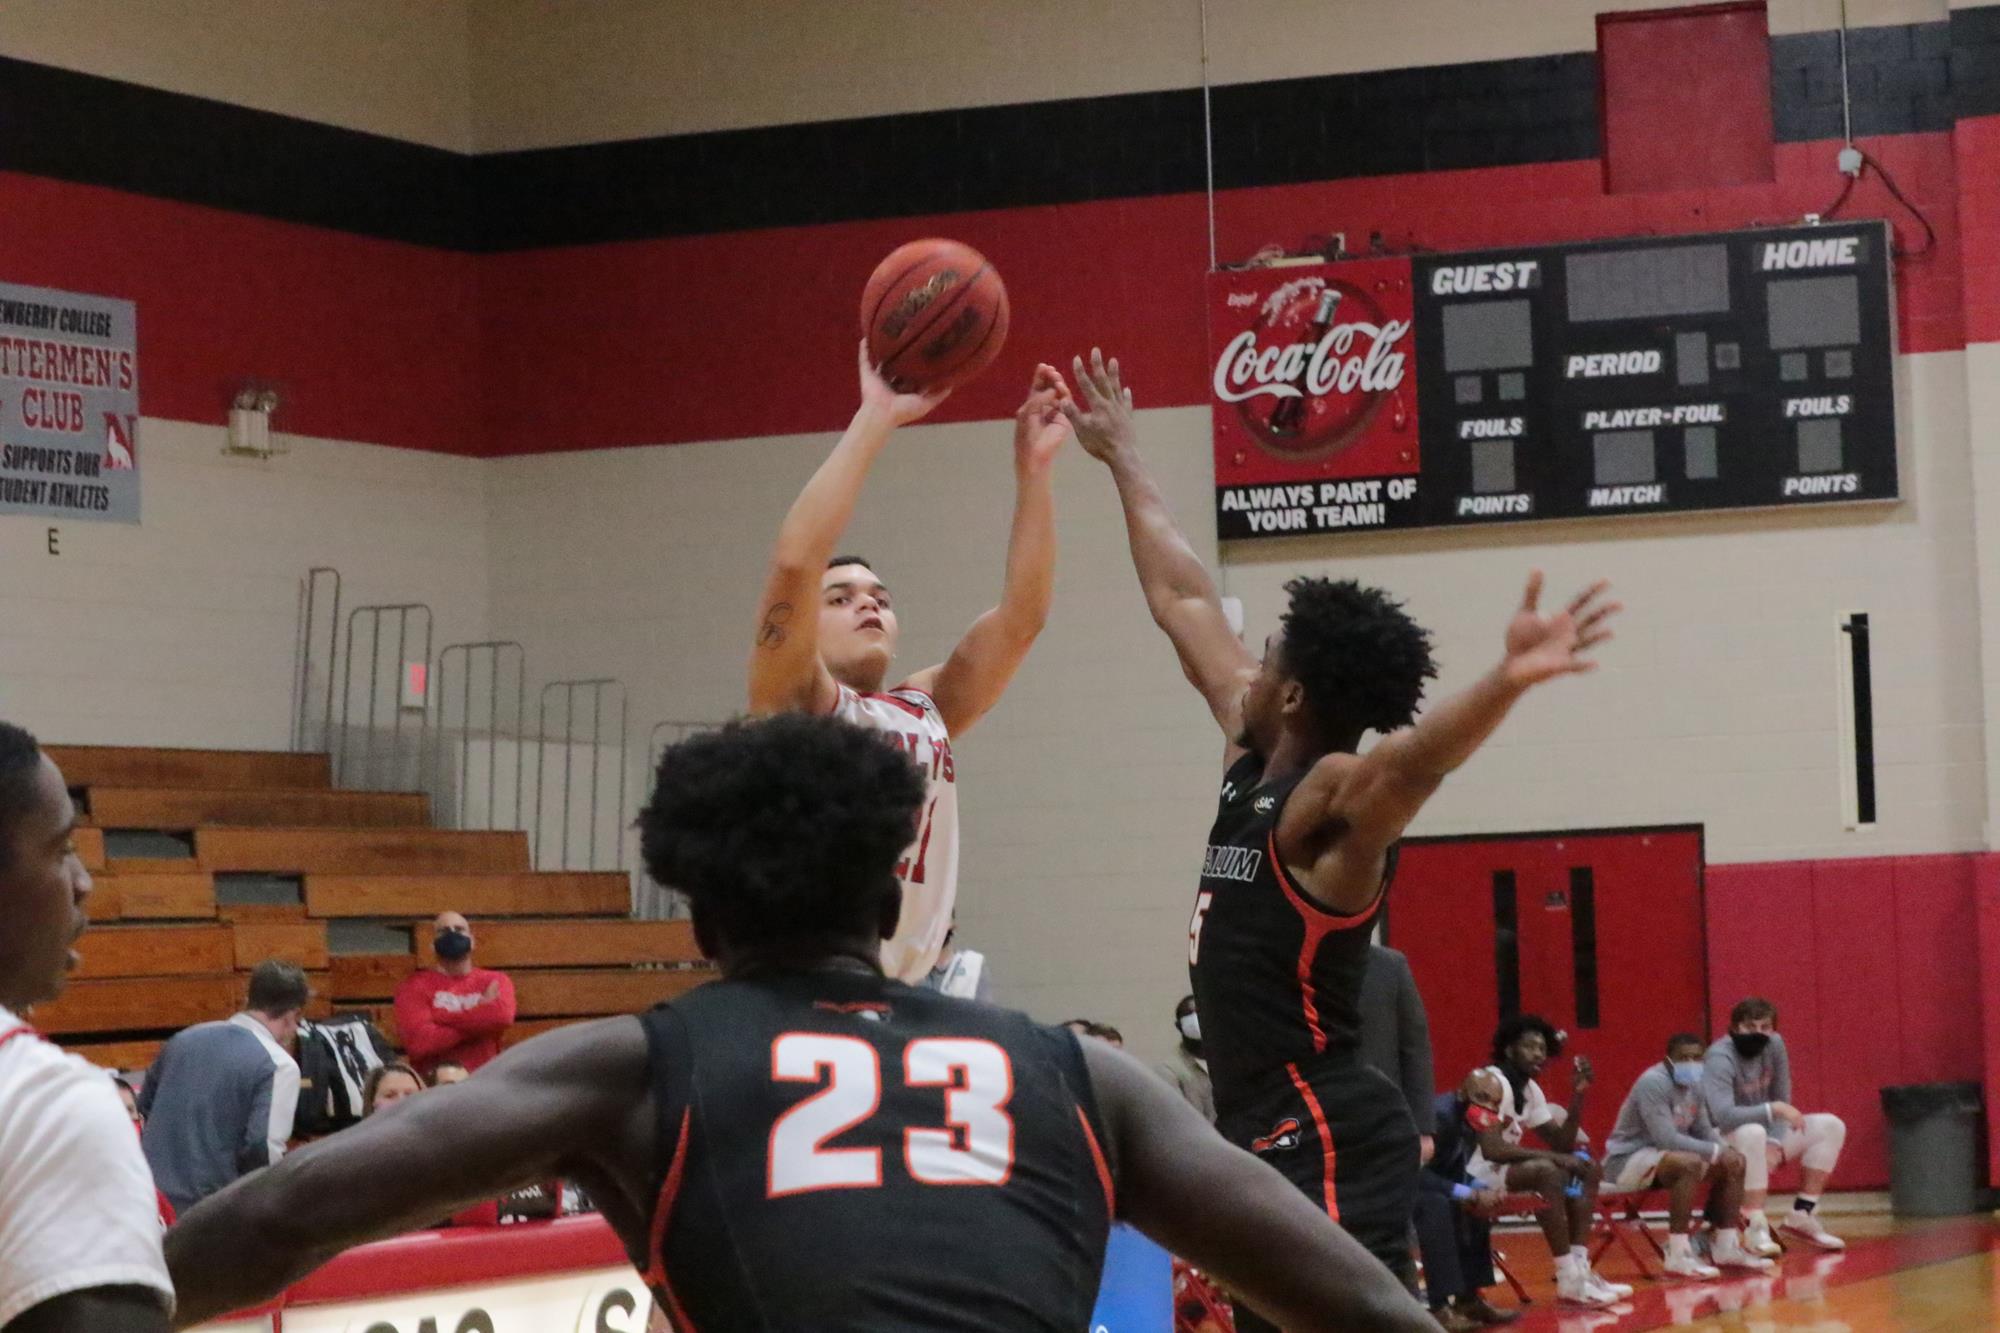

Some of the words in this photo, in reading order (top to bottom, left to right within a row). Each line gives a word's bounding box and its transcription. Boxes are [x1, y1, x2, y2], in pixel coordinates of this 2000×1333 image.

[1762, 238, 1859, 271] HOME
[1431, 262, 1537, 294] GUEST
[60, 308, 111, 337] COLLEGE
[1213, 320, 1411, 402] Coca-Cola
[1567, 351, 1661, 379] PERIOD
[22, 387, 84, 432] CLUB
[1585, 404, 1724, 429] PLAYER-FOUL
[1785, 395, 1850, 417] FOULS
[1460, 417, 1523, 439] FOULS
[2, 444, 73, 475] SUPPORTS
[74, 451, 101, 478] OUR
[49, 482, 110, 511] ATHLETES
[1222, 485, 1314, 511] ALWAYS
[1320, 481, 1382, 506] PART
[1388, 478, 1417, 501] OF
[1590, 486, 1661, 507] MATCH
[1784, 474, 1857, 496] POINTS
[1247, 508, 1308, 532] YOUR
[1315, 504, 1386, 528] TEAM!
[1458, 495, 1530, 516] POINTS
[47, 527, 60, 556] E
[766, 1030, 1015, 1199] 23
